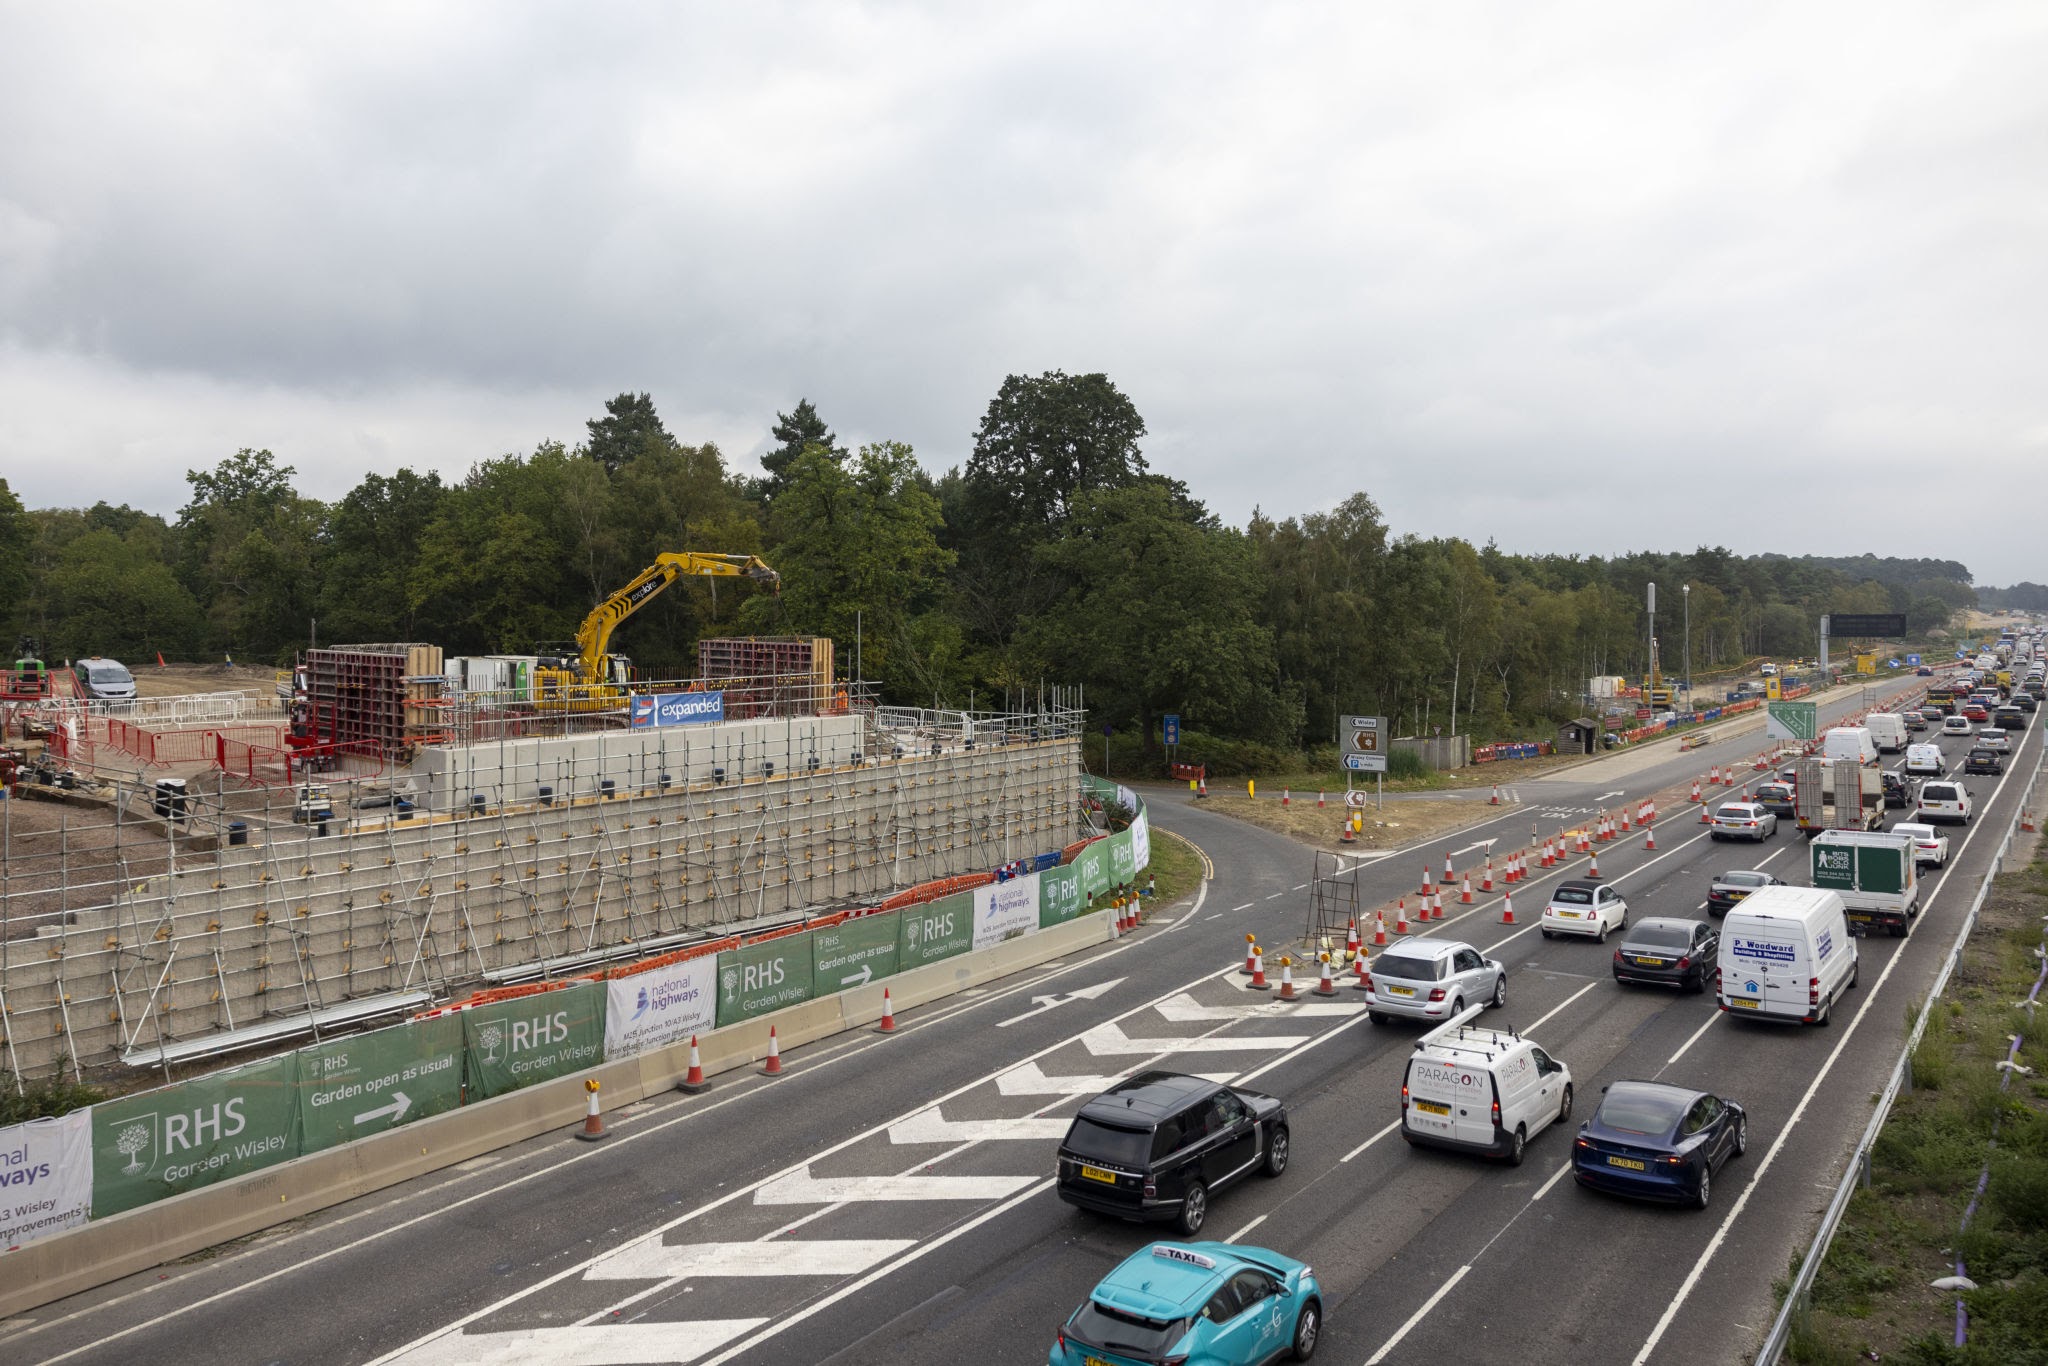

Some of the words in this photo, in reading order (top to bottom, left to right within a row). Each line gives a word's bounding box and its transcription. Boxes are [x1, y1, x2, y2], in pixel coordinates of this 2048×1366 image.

[632, 581, 657, 601] explore
[661, 696, 720, 720] expanded
[998, 897, 1030, 912] highways
[924, 912, 954, 943] RHS
[825, 935, 840, 947] RHS
[922, 943, 947, 958] Garden
[948, 938, 968, 951] Wisley
[1735, 939, 1743, 948] P.
[1747, 940, 1794, 953] Woodward
[819, 954, 846, 971] Garden
[847, 951, 866, 964] open
[867, 947, 875, 956] as
[876, 941, 895, 955] usual
[652, 975, 690, 997] national
[744, 957, 785, 993] RHS
[652, 988, 699, 1011] highways
[743, 994, 777, 1011] Garden
[779, 986, 808, 1002] Wisley
[513, 1011, 568, 1053] RHS
[638, 1023, 663, 1037] Junction
[324, 1053, 349, 1072] RHS
[511, 1054, 556, 1074] Garden
[559, 1042, 598, 1061] Wisley
[1501, 1056, 1530, 1081] PARAGON
[311, 1084, 362, 1107] Garden
[365, 1073, 399, 1093] open
[402, 1067, 417, 1081] as
[420, 1054, 453, 1076] usual
[1417, 1066, 1483, 1088] PARAGON
[165, 1096, 246, 1156] RHS
[164, 1152, 230, 1182] Garden
[234, 1132, 288, 1161] Wisley
[15, 1199, 57, 1218] Wisley
[1168, 1249, 1195, 1263] TAXI
